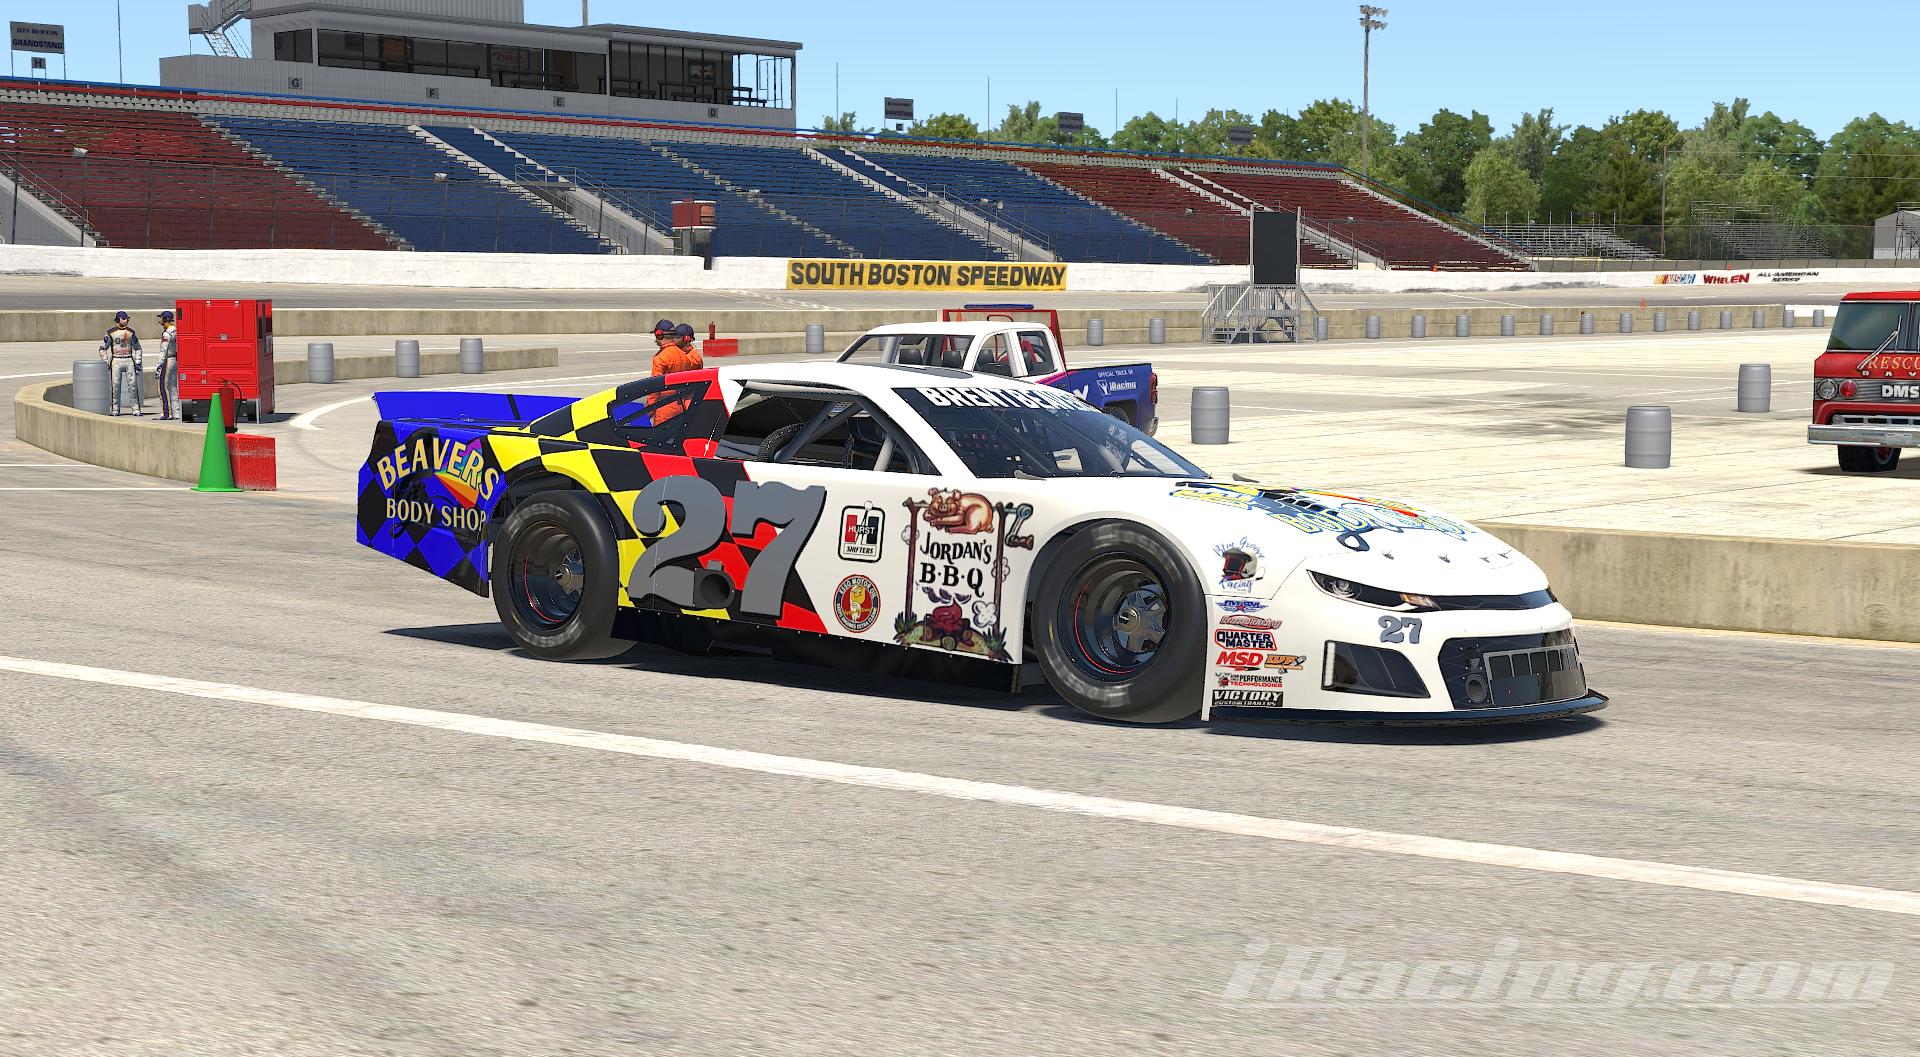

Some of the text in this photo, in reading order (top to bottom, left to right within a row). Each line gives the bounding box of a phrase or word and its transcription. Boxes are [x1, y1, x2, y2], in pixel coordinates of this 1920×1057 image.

[12, 38, 63, 49] GRANDSTAND
[34, 58, 42, 68] H
[291, 78, 300, 88] G
[791, 262, 1066, 287] SOUTH BOSTON SPEEDWAY
[1702, 272, 1750, 285] WHELEN
[1109, 380, 1137, 392] iRacing
[1881, 384, 1920, 399] DMS
[915, 387, 1022, 408] BRENT
[376, 437, 499, 501] BEAVERS
[386, 497, 435, 525] BODY
[441, 505, 487, 532] SHOP
[848, 525, 876, 535] HURST
[628, 474, 827, 618] 27
[846, 545, 875, 555] SHIFTERS
[1377, 614, 1423, 645] 27
[1216, 631, 1271, 643] QUARTER
[1225, 638, 1274, 649] MASTER
[1216, 651, 1264, 666] MSD
[1239, 674, 1283, 684] PERFORMANCE
[1213, 690, 1283, 702] VICTORY
